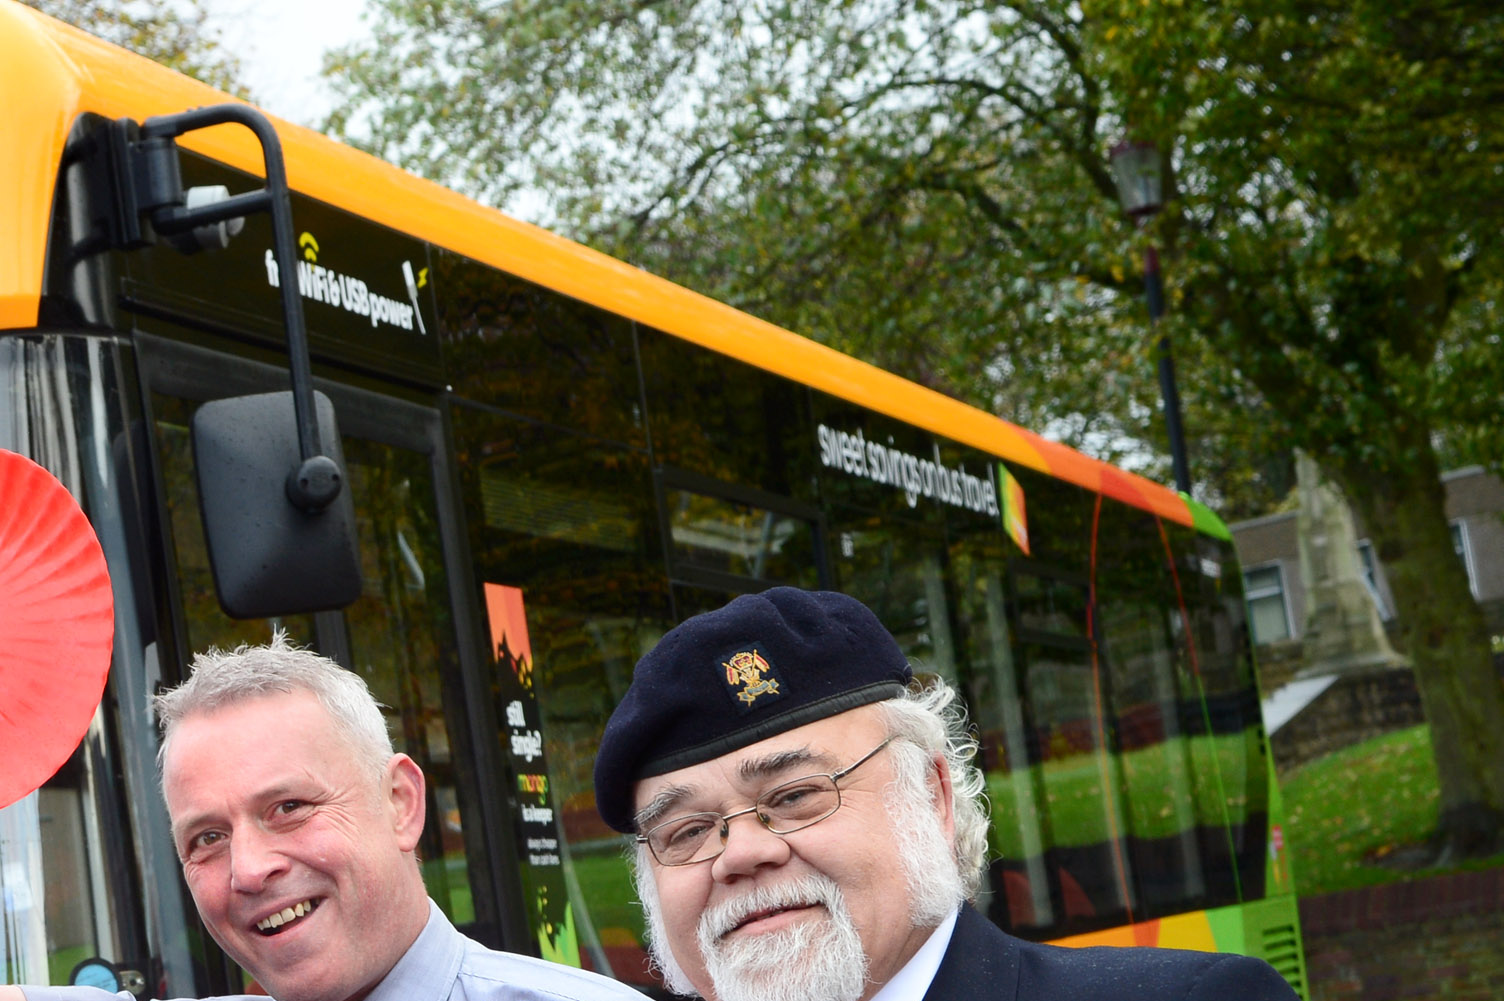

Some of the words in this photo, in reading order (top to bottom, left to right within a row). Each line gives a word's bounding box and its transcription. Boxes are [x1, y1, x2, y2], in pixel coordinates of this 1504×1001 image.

[338, 274, 371, 317] USB
[368, 292, 414, 330] power
[818, 424, 870, 477] sweet
[867, 435, 922, 508] savings
[933, 441, 964, 507] bus
[959, 462, 1000, 517] travel
